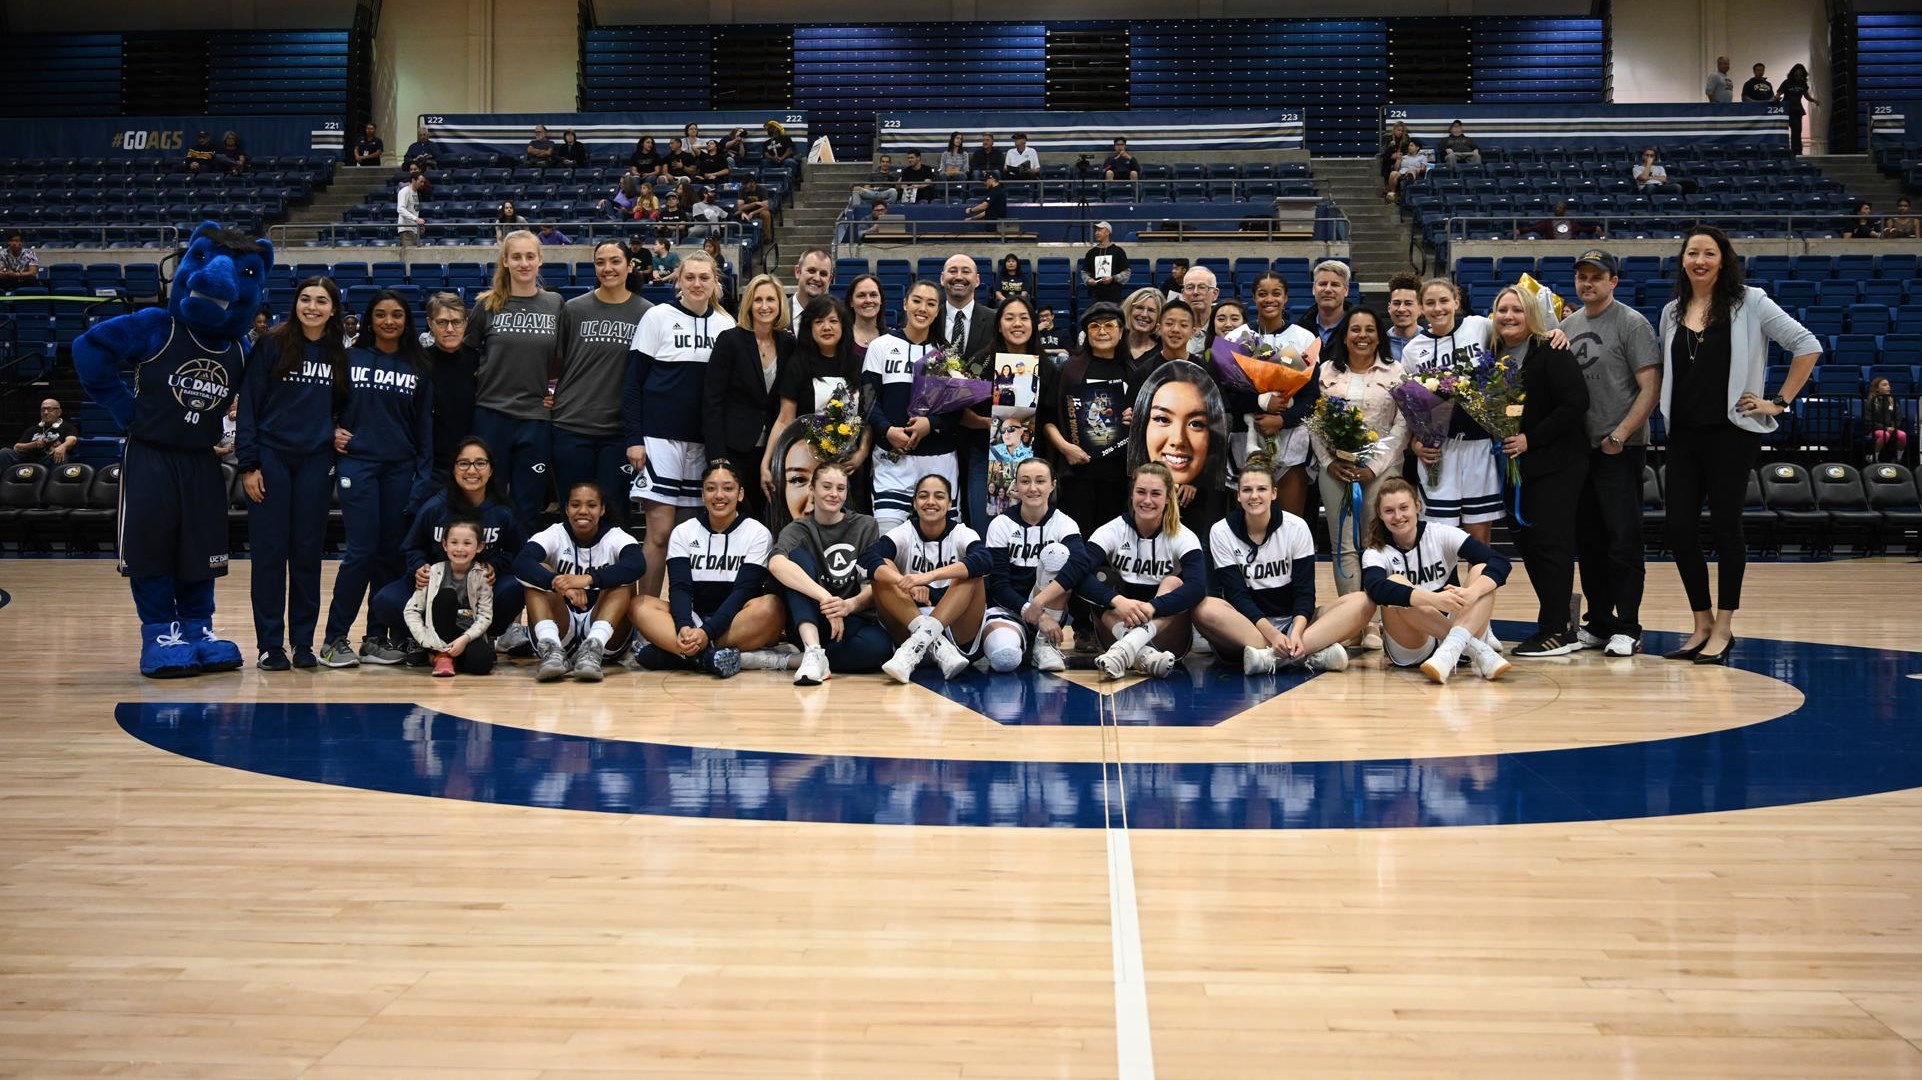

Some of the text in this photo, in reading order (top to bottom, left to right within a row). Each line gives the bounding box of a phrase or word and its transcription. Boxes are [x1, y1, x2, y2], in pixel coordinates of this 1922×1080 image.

[1281, 113, 1298, 121] 223
[1390, 110, 1407, 118] 224
[1767, 106, 1784, 114] 224
[1874, 106, 1892, 114] 225
[324, 122, 339, 130] 221
[427, 116, 443, 124] 222
[786, 115, 802, 123] 222
[884, 120, 901, 128] 223
[111, 130, 184, 150] #GOAGS
[492, 313, 556, 330] UC DAVIS
[580, 320, 600, 337] UC
[584, 337, 632, 346] BASKETBA
[674, 334, 716, 350] UC DAV
[302, 360, 334, 380] DAV
[885, 359, 902, 374] UC
[350, 366, 419, 390] UC DAVIS
[354, 383, 414, 396] BASKETALL
[184, 410, 200, 425] 40
[1069, 418, 1080, 445] OPHIA
[688, 554, 706, 570] UC
[1113, 554, 1174, 576] UC DAVIS
[1407, 560, 1447, 585] DAVIS
